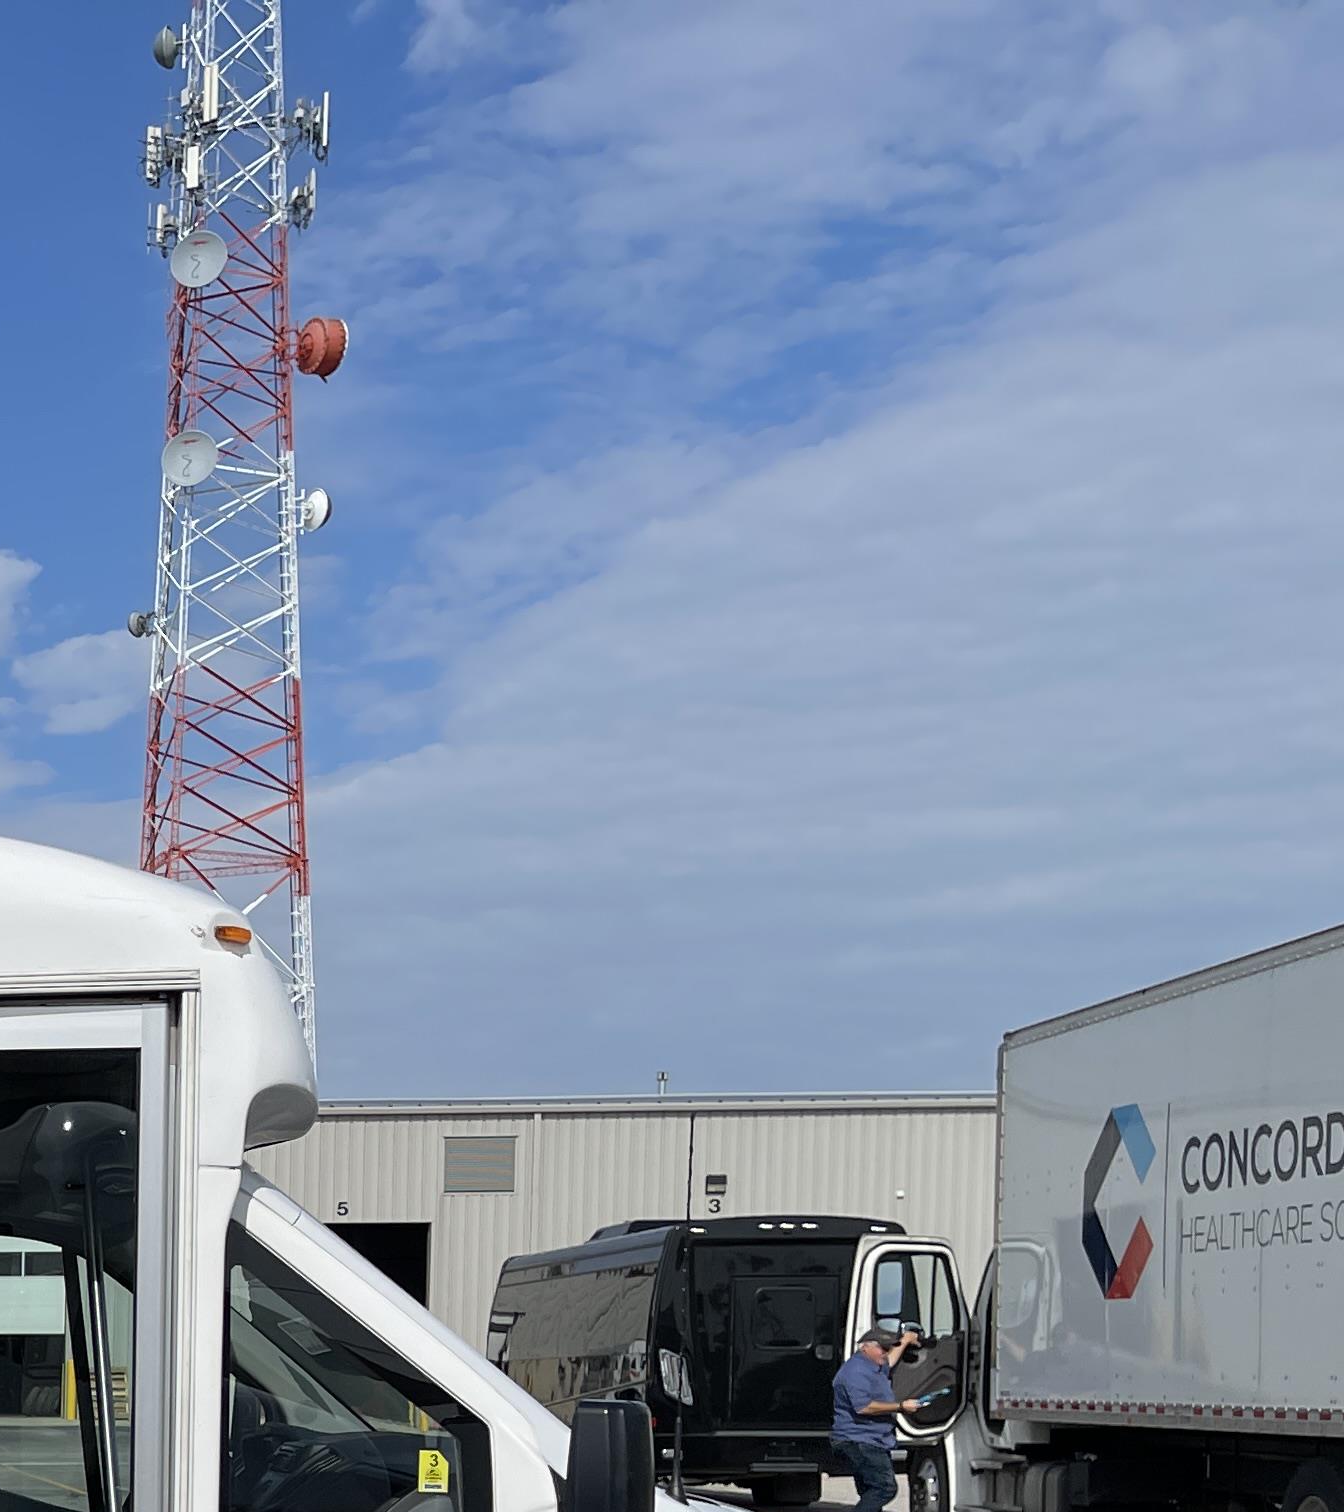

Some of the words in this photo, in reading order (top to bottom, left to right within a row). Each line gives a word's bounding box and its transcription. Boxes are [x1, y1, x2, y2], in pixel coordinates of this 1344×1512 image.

[1181, 1112, 1344, 1194] CONCORD
[337, 1201, 349, 1216] 5
[709, 1198, 721, 1214] 3
[1181, 1204, 1313, 1255] HEALTHCARE
[429, 1453, 439, 1468] 3
